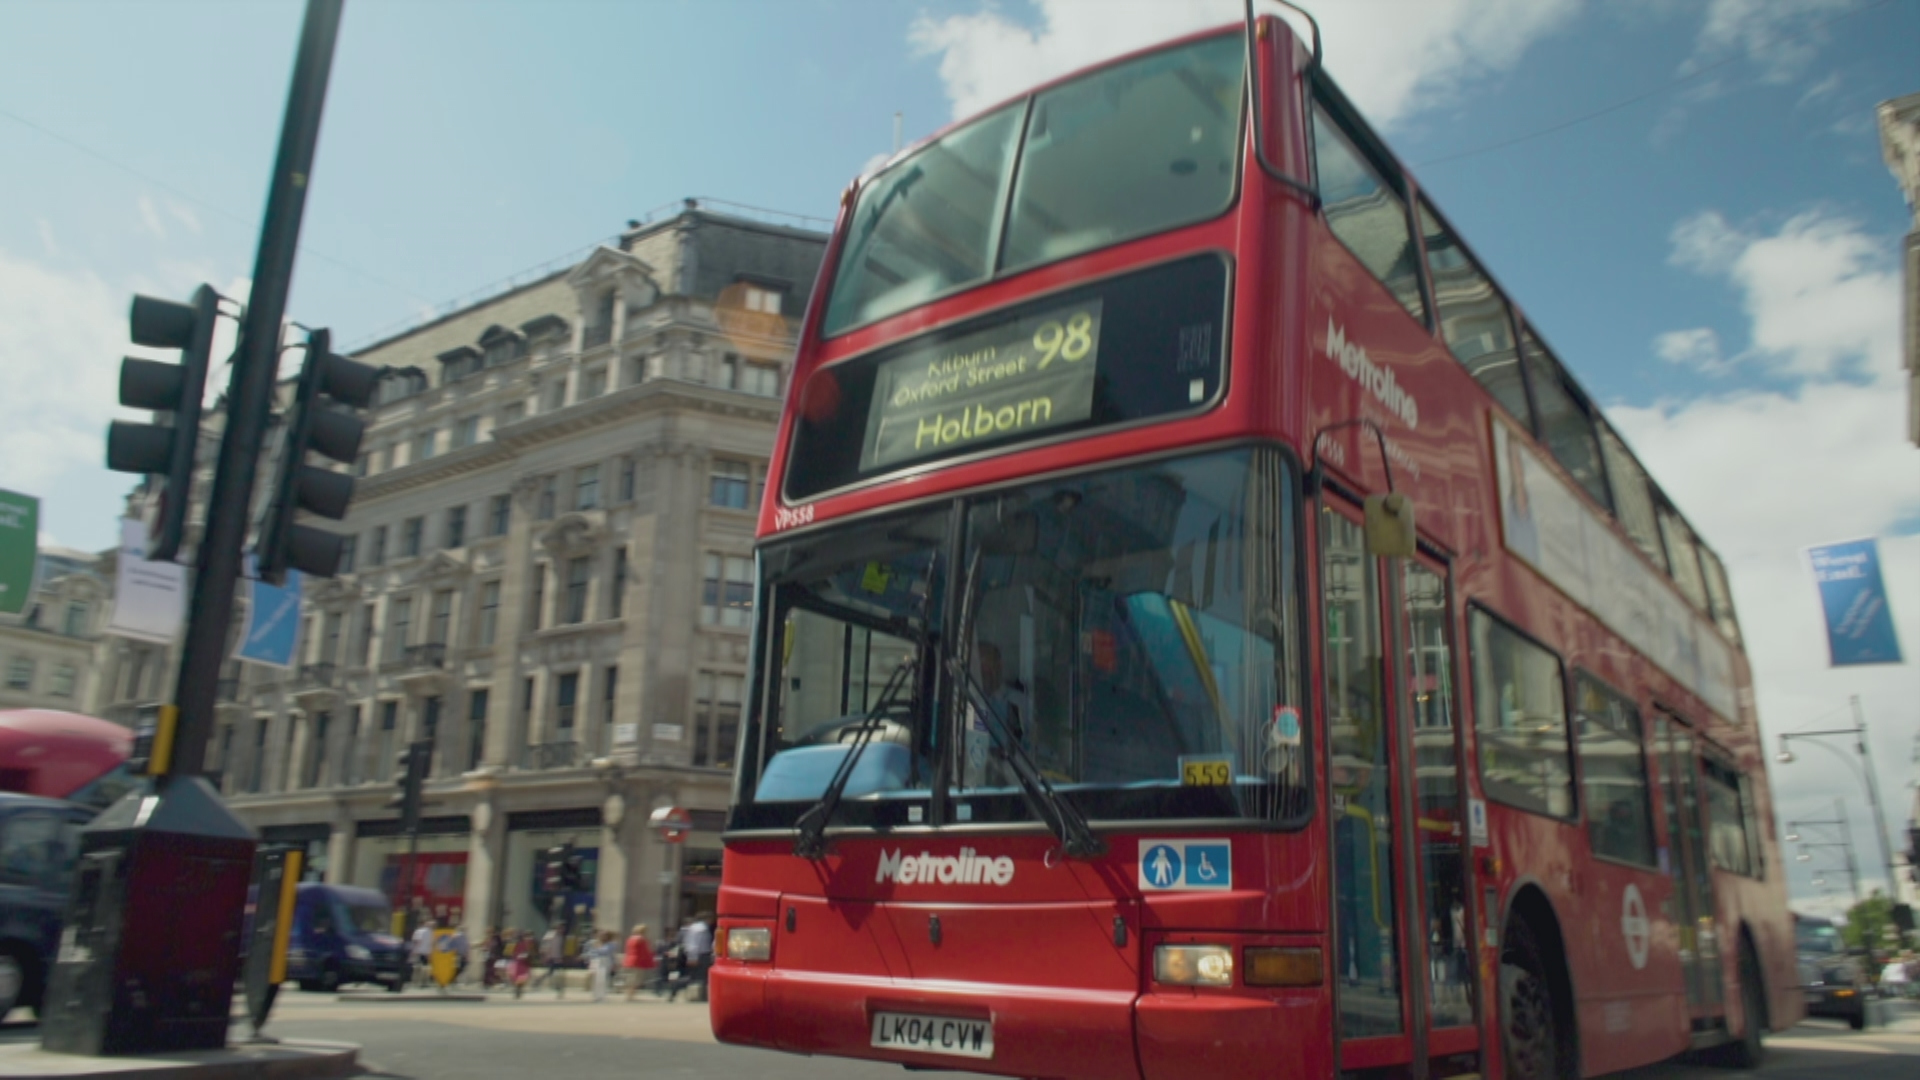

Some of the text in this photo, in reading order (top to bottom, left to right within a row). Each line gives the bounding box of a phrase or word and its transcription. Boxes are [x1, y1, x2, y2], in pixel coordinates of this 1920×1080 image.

[927, 346, 997, 378] Kilburn
[1033, 311, 1092, 370] 98
[894, 355, 1028, 408] Oxford Street
[1326, 313, 1419, 431] Metroline
[915, 396, 1052, 451] Holborn
[1185, 764, 1230, 786] 559
[875, 846, 1014, 886] Metroline
[878, 1018, 985, 1051] LK04 CVW
